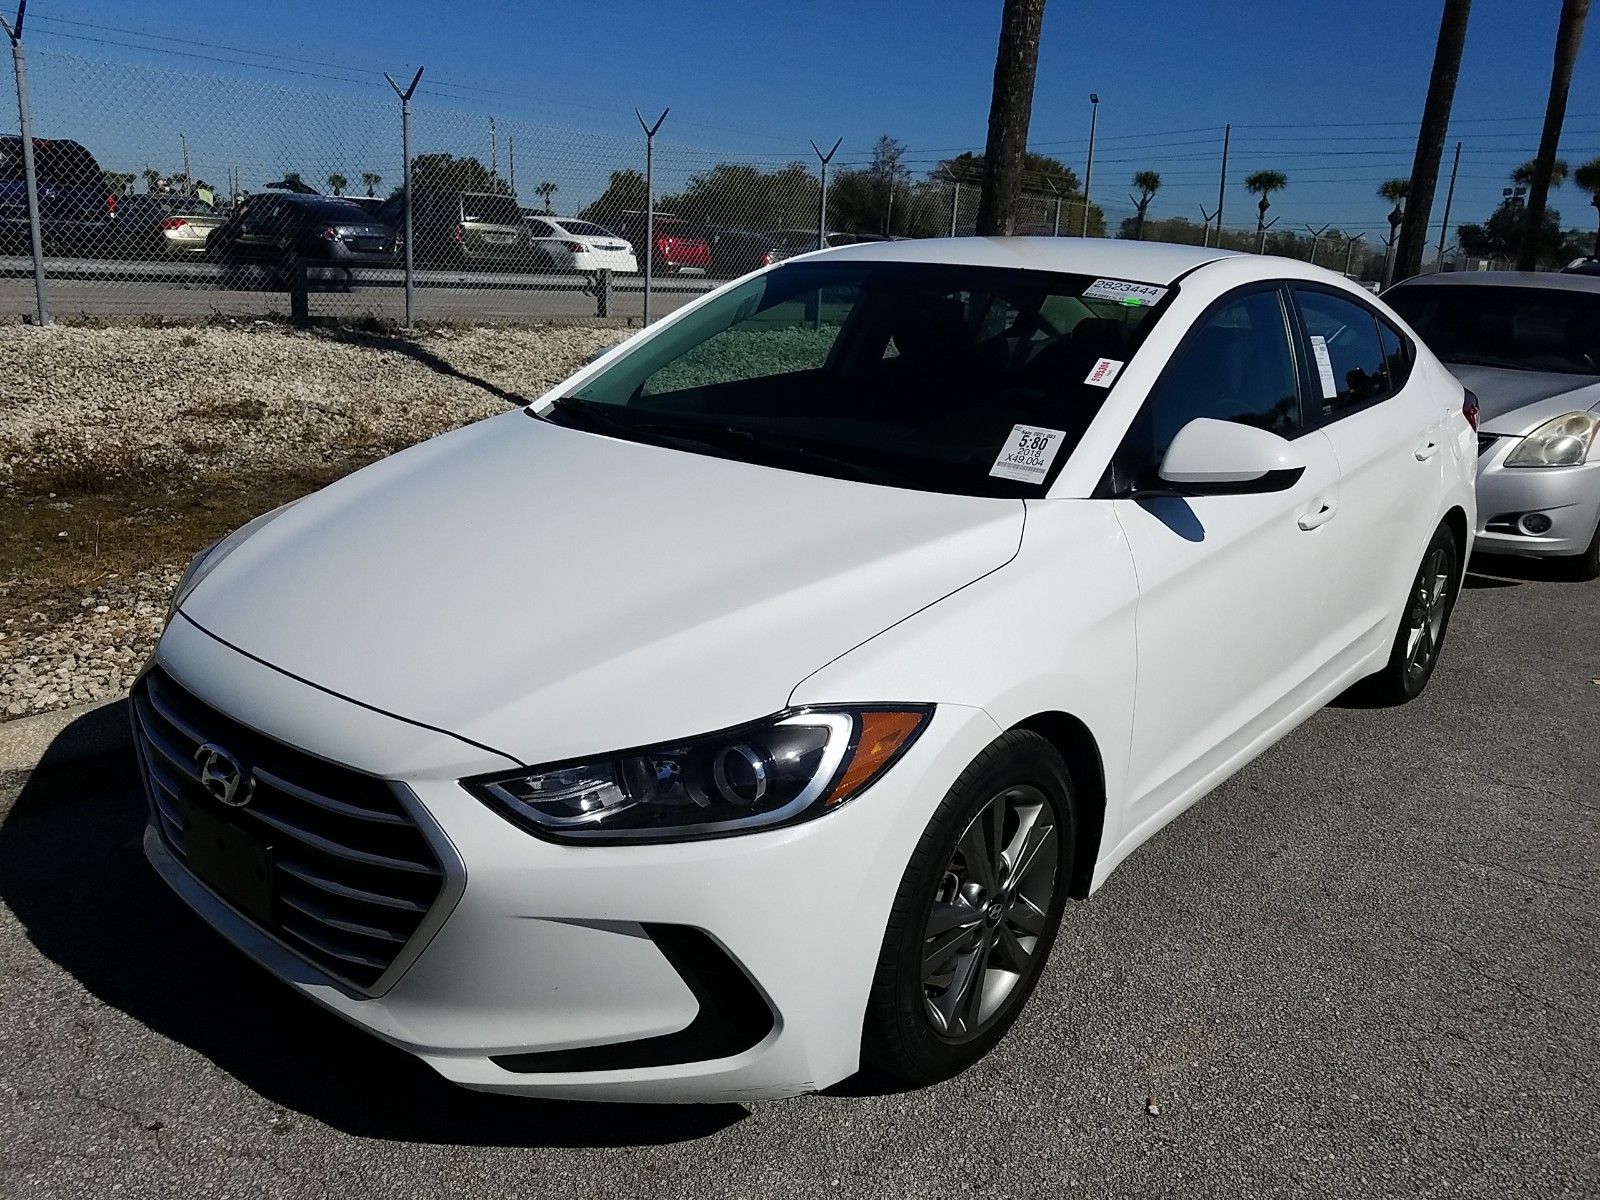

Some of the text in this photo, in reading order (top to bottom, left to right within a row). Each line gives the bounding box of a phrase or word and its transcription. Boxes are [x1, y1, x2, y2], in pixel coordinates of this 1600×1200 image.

[1093, 280, 1159, 296] 2823444
[1019, 435, 1049, 451] 5:80
[1017, 447, 1042, 458] 2018
